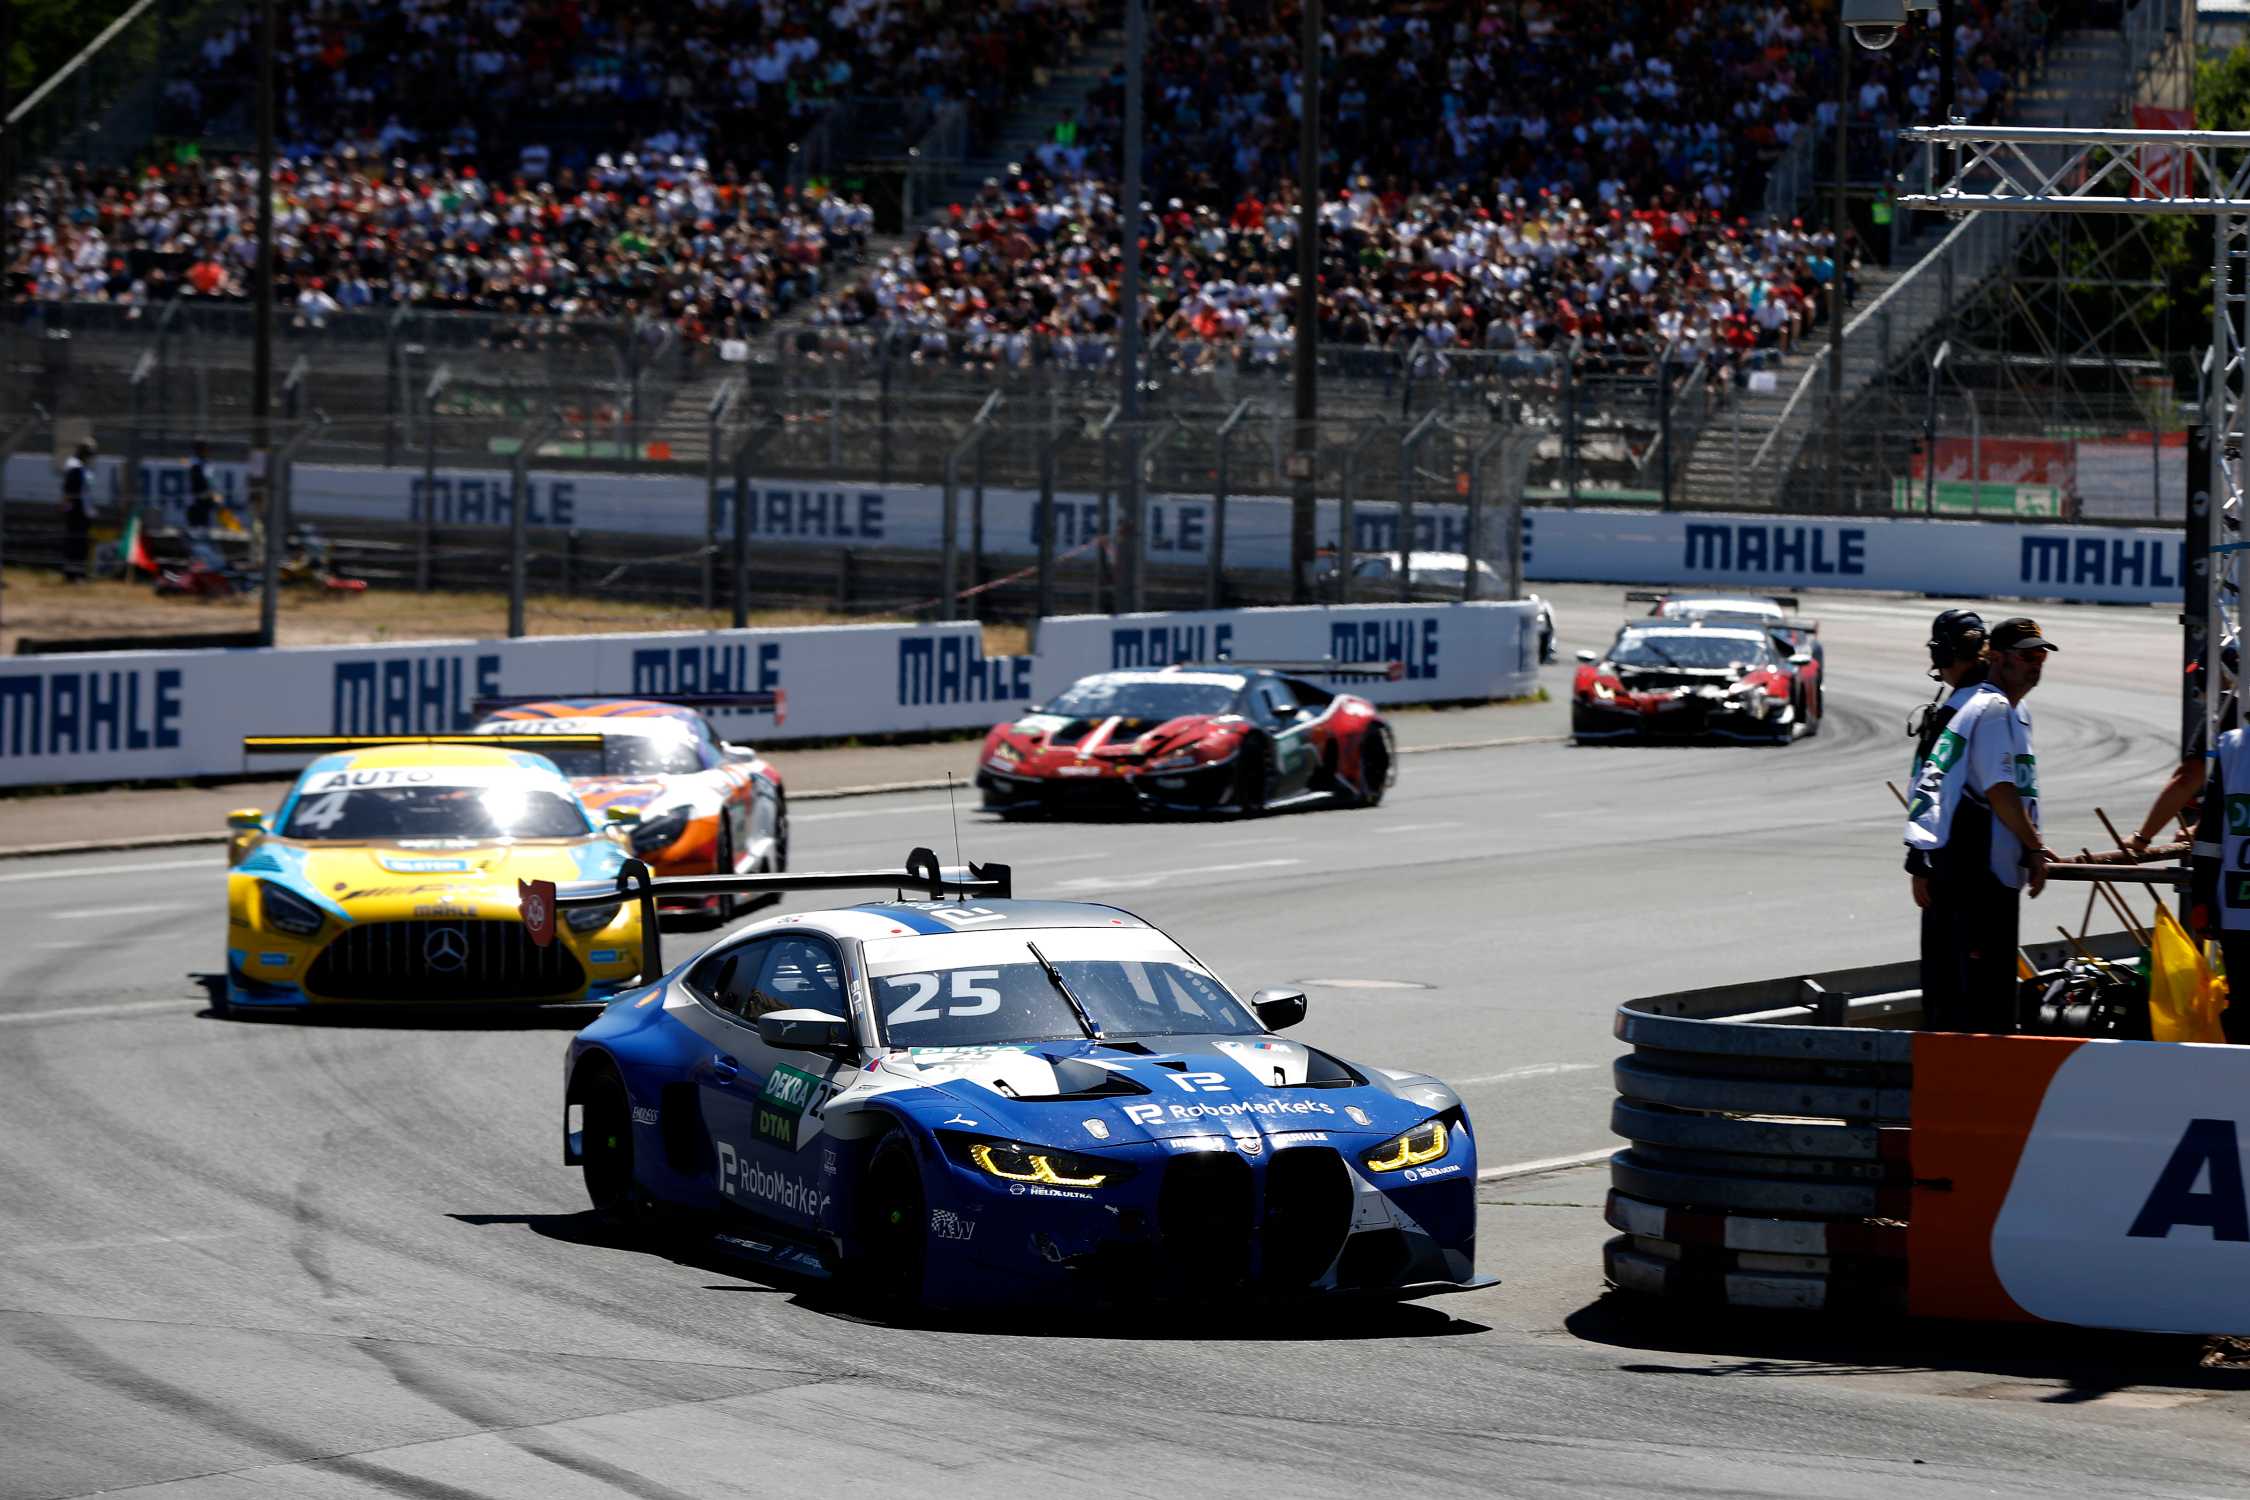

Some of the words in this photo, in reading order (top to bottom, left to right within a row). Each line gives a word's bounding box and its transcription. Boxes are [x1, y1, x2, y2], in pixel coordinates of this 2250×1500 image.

[1030, 502, 1205, 550] MALE
[1684, 524, 1865, 575] MAHLE
[2020, 536, 2186, 588] MAHL
[1330, 618, 1438, 684] MAHLE
[0, 669, 181, 757] MAHLE
[321, 770, 433, 790] AUTO
[294, 790, 350, 831] 4
[886, 969, 1001, 1026] 25
[766, 1070, 810, 1108] DEKRA
[1168, 1100, 1335, 1119] RoboMarkets
[760, 1110, 790, 1142] DTM
[2125, 1118, 2250, 1243] A
